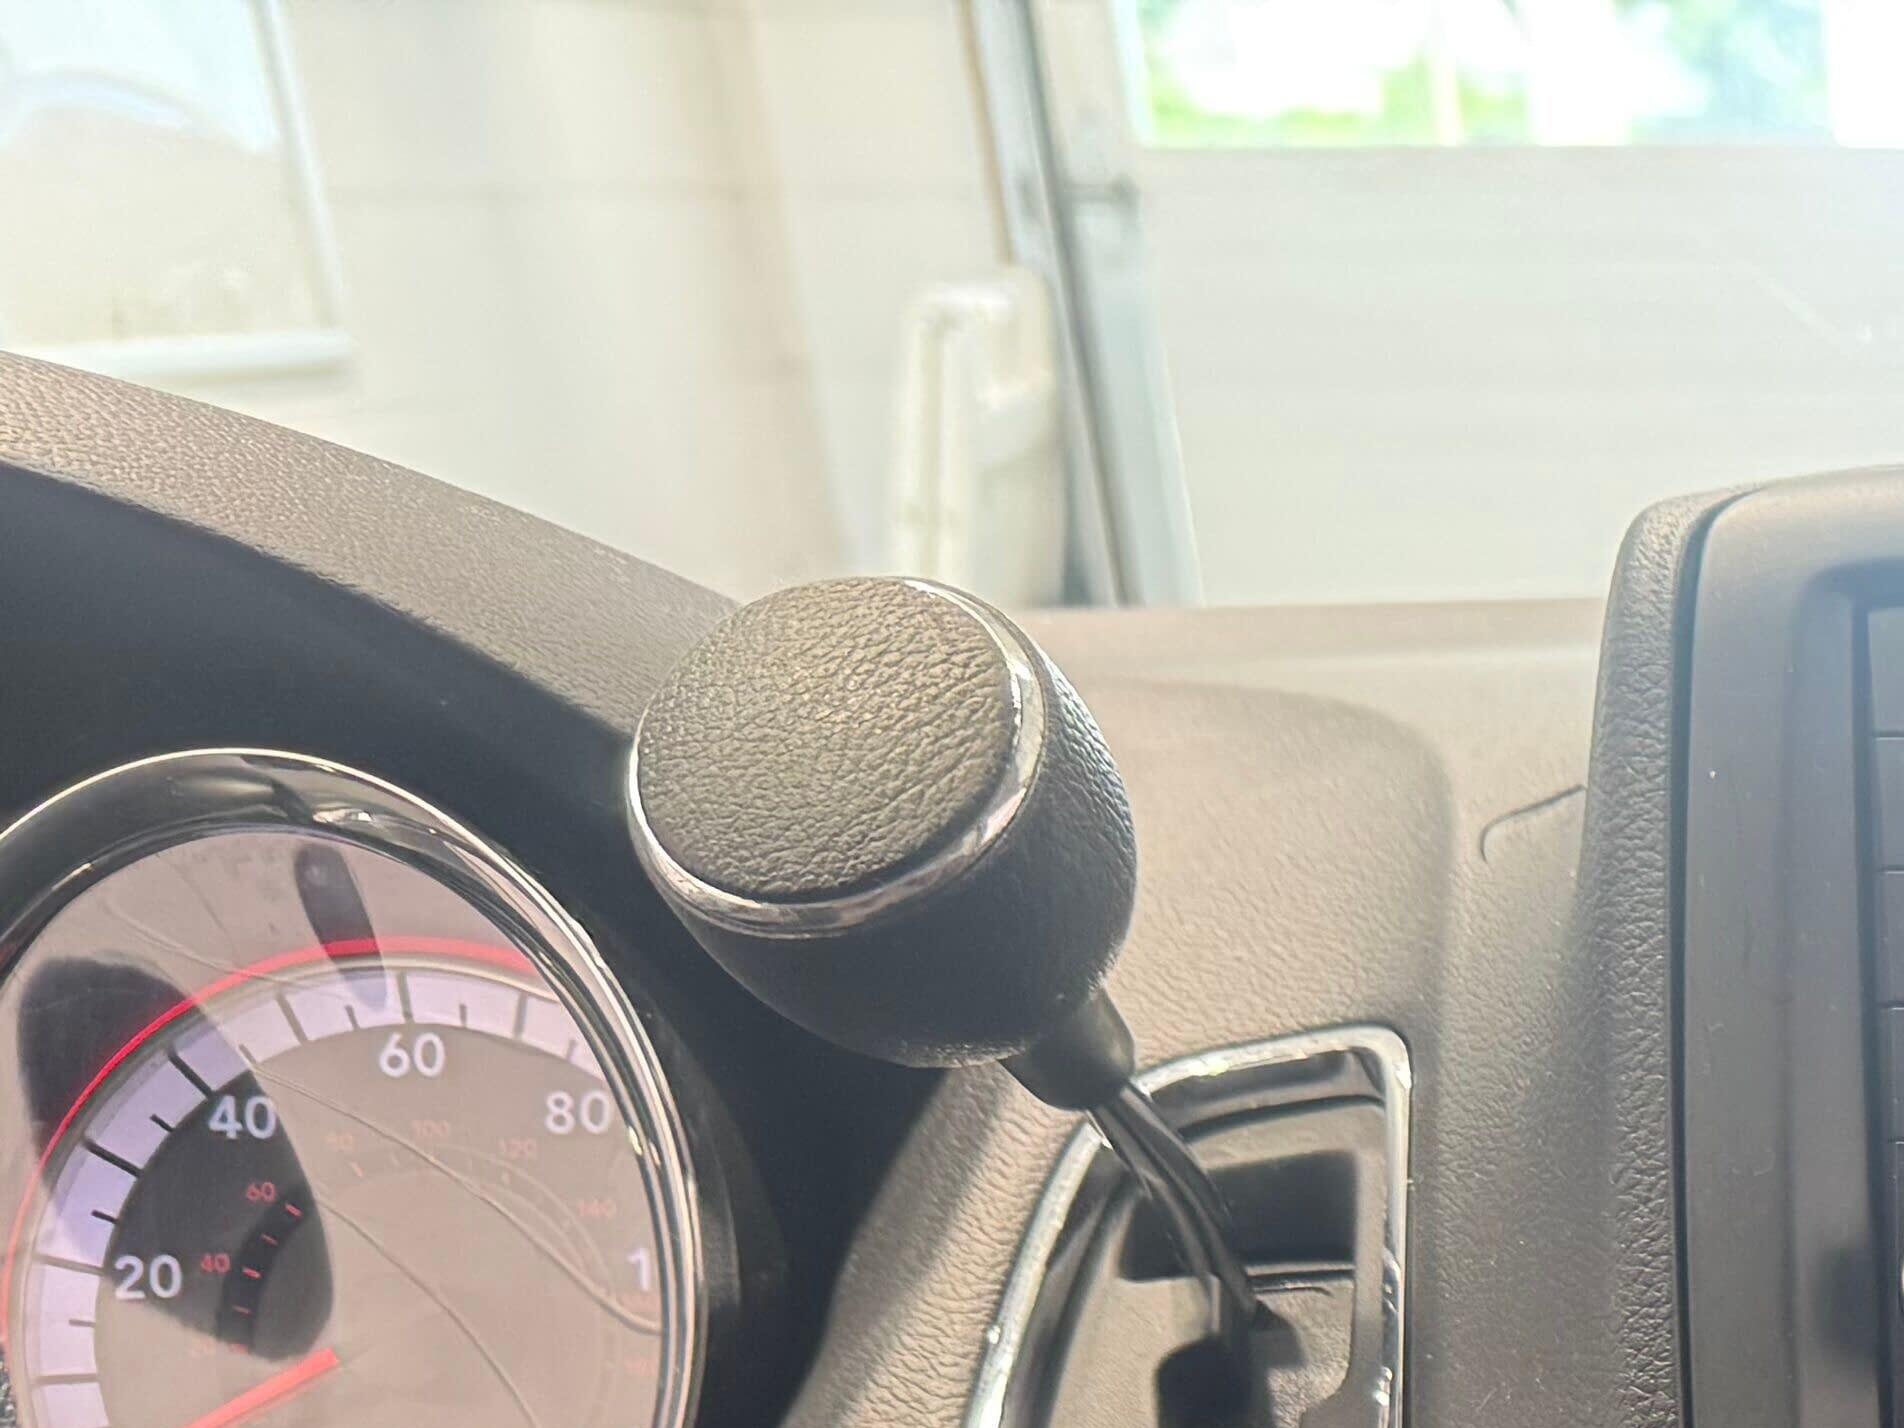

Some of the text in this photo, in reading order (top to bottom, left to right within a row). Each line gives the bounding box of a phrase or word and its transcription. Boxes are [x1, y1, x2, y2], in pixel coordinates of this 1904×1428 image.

[380, 1033, 445, 1077] 60
[208, 1096, 278, 1139] 40
[546, 1090, 613, 1135] 80
[112, 1256, 180, 1300] 20
